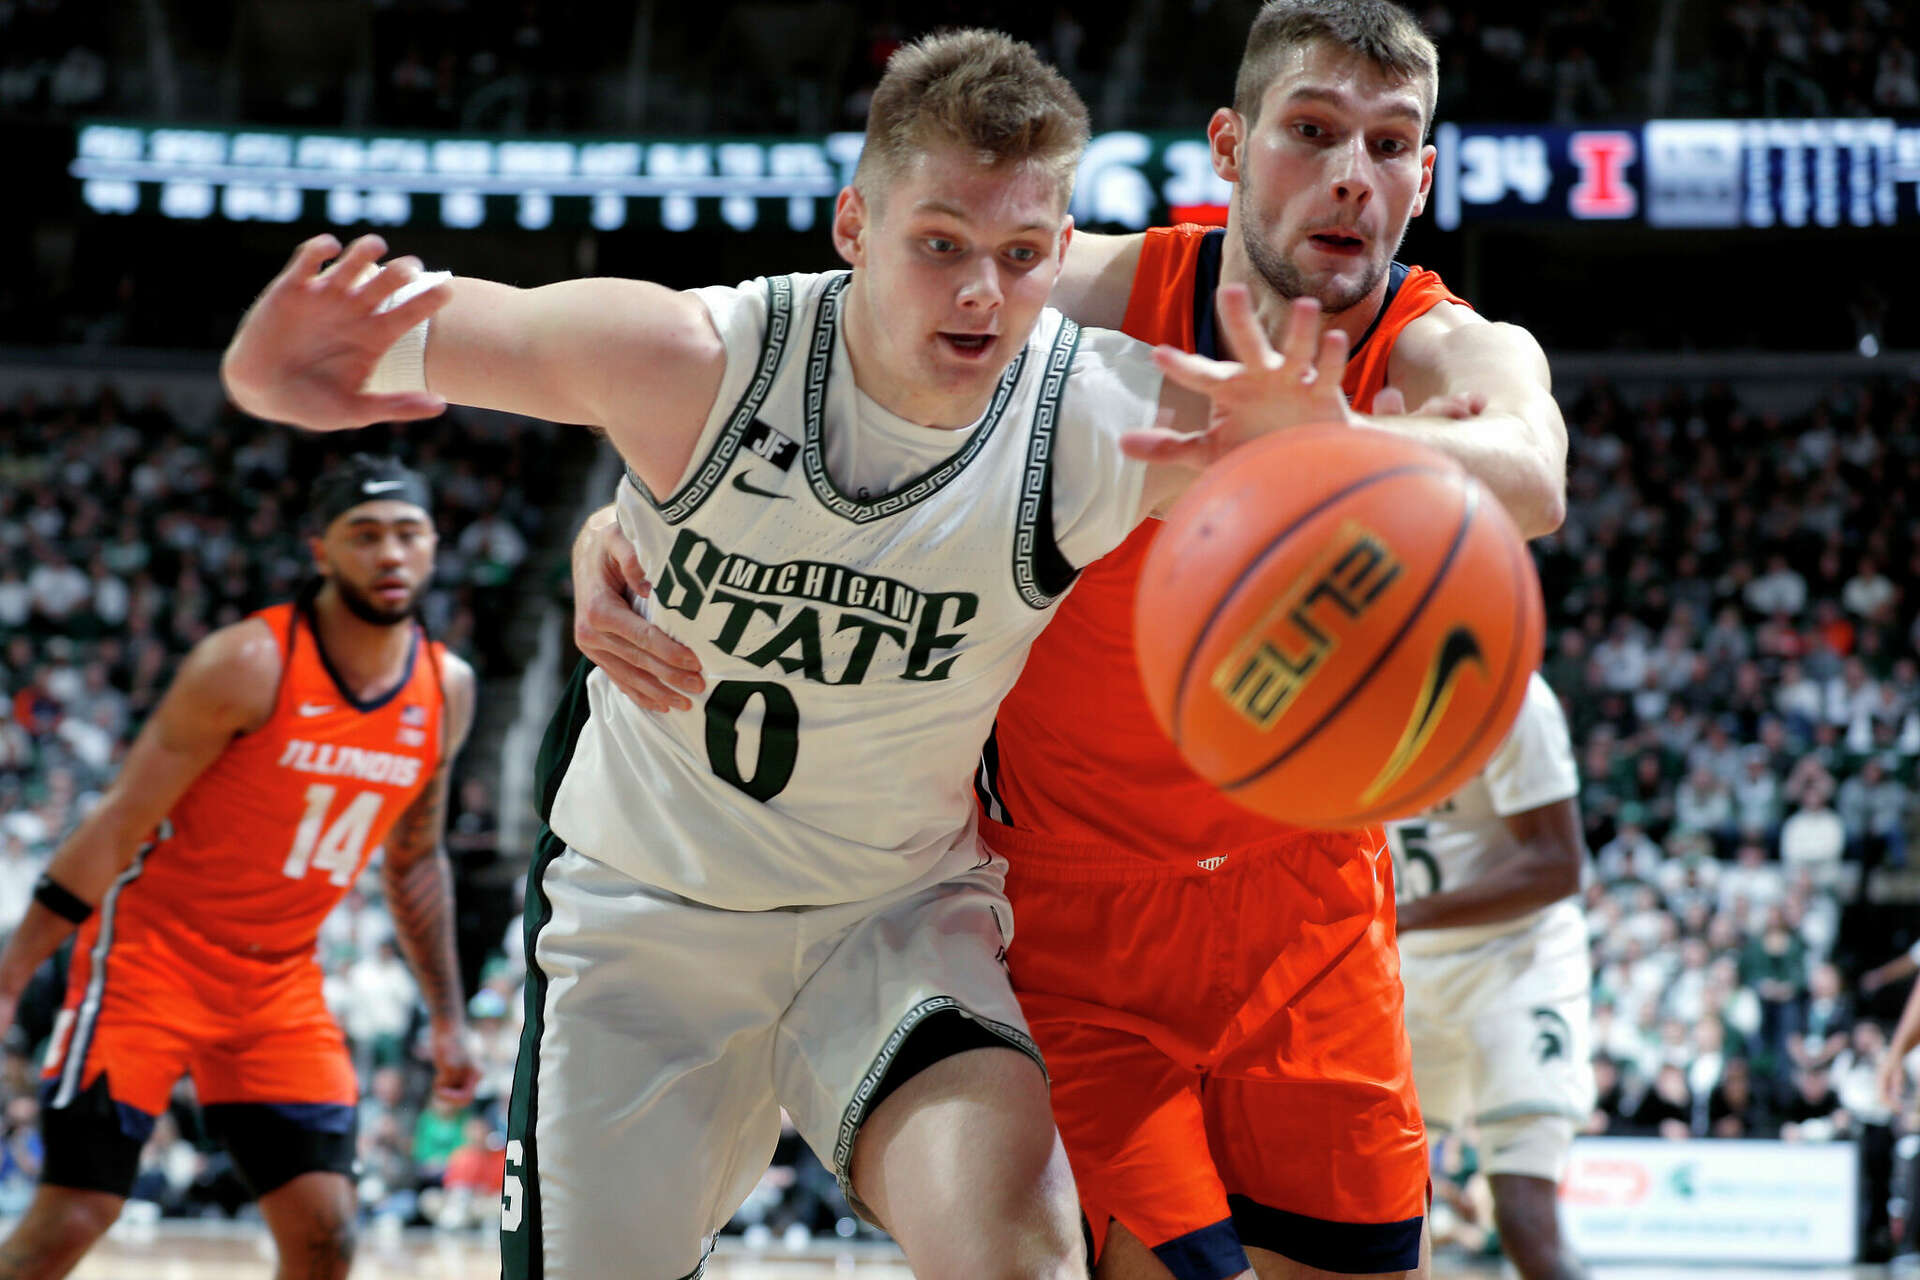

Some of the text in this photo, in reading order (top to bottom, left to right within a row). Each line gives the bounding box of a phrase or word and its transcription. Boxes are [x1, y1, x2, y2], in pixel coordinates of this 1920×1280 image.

[653, 528, 980, 686] STATE
[725, 557, 914, 623] MICHIGAN
[1226, 535, 1403, 726] ELITE
[278, 739, 423, 788] ILLINOIS
[704, 679, 800, 804] 0
[283, 782, 385, 888] 14
